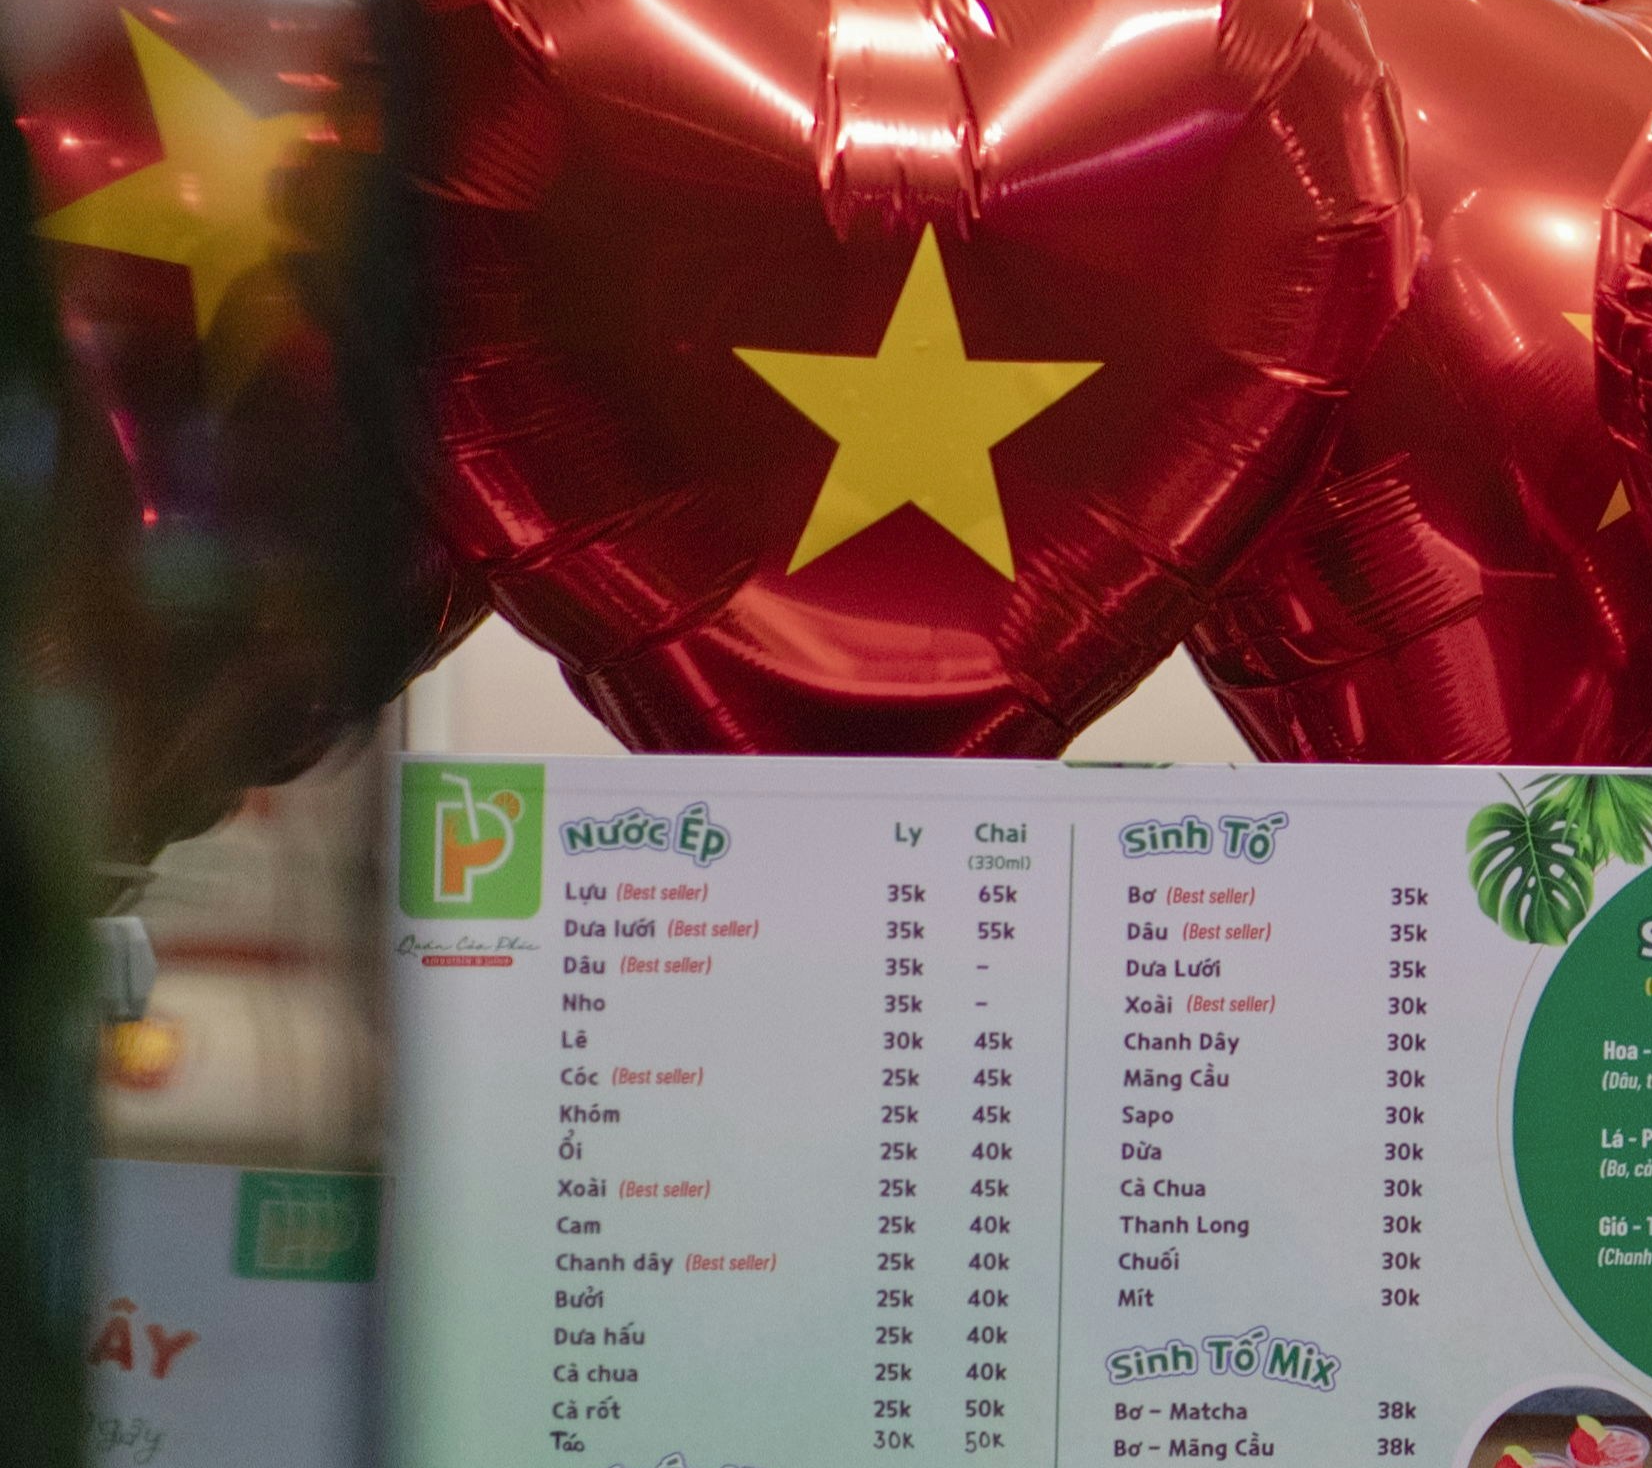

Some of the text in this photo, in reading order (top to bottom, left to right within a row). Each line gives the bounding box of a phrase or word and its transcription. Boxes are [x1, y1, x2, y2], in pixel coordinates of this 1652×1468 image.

[561, 804, 1027, 863] Nước Ép Ly Chai
[1120, 813, 1288, 861] Sinh Tố
[967, 855, 1031, 870] (330ml)
[565, 882, 1017, 905] Lựu (Best seller) 35k 65k
[564, 918, 1015, 940] Dưa lưới (Best seller) 35k 55k
[1126, 958, 1426, 979] Dưa Lưới 35k
[561, 1030, 1013, 1050] Lê 30k 45k
[1123, 1063, 1425, 1092] Mãng Cầu 30k
[559, 1103, 1011, 1124] Khóm 25k 45k
[556, 1215, 1010, 1235] Cam 25k 40k
[1110, 1330, 1337, 1389] Sinh Tố Mix
